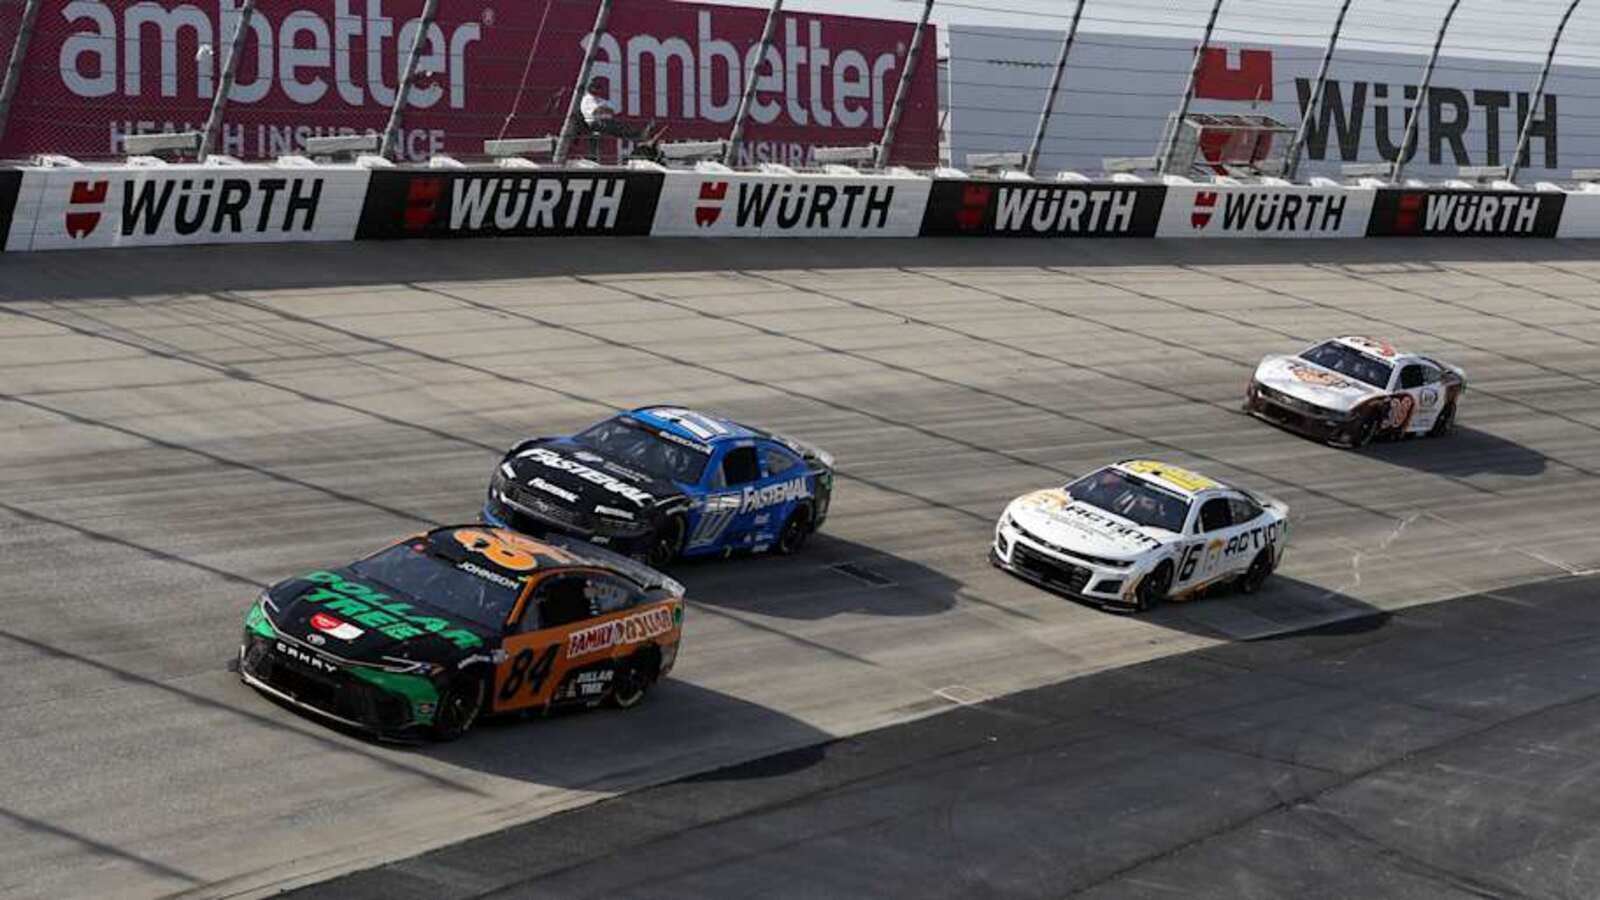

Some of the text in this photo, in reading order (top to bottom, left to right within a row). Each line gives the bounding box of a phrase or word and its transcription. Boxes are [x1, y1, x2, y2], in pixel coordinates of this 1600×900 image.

[59, 0, 480, 108] ambetter
[580, 10, 896, 129] ambetter
[258, 124, 445, 161] INSNCE
[516, 448, 656, 507] FASTENAL
[740, 477, 809, 514] FASTENAL
[1065, 505, 1163, 550] ACTION
[457, 561, 520, 590] JOHNSON
[305, 570, 483, 649] DOLLAR
[305, 587, 426, 640] TREE
[276, 641, 337, 672] CAMRY
[568, 621, 614, 656] FAMILY
[499, 641, 561, 699] 84
